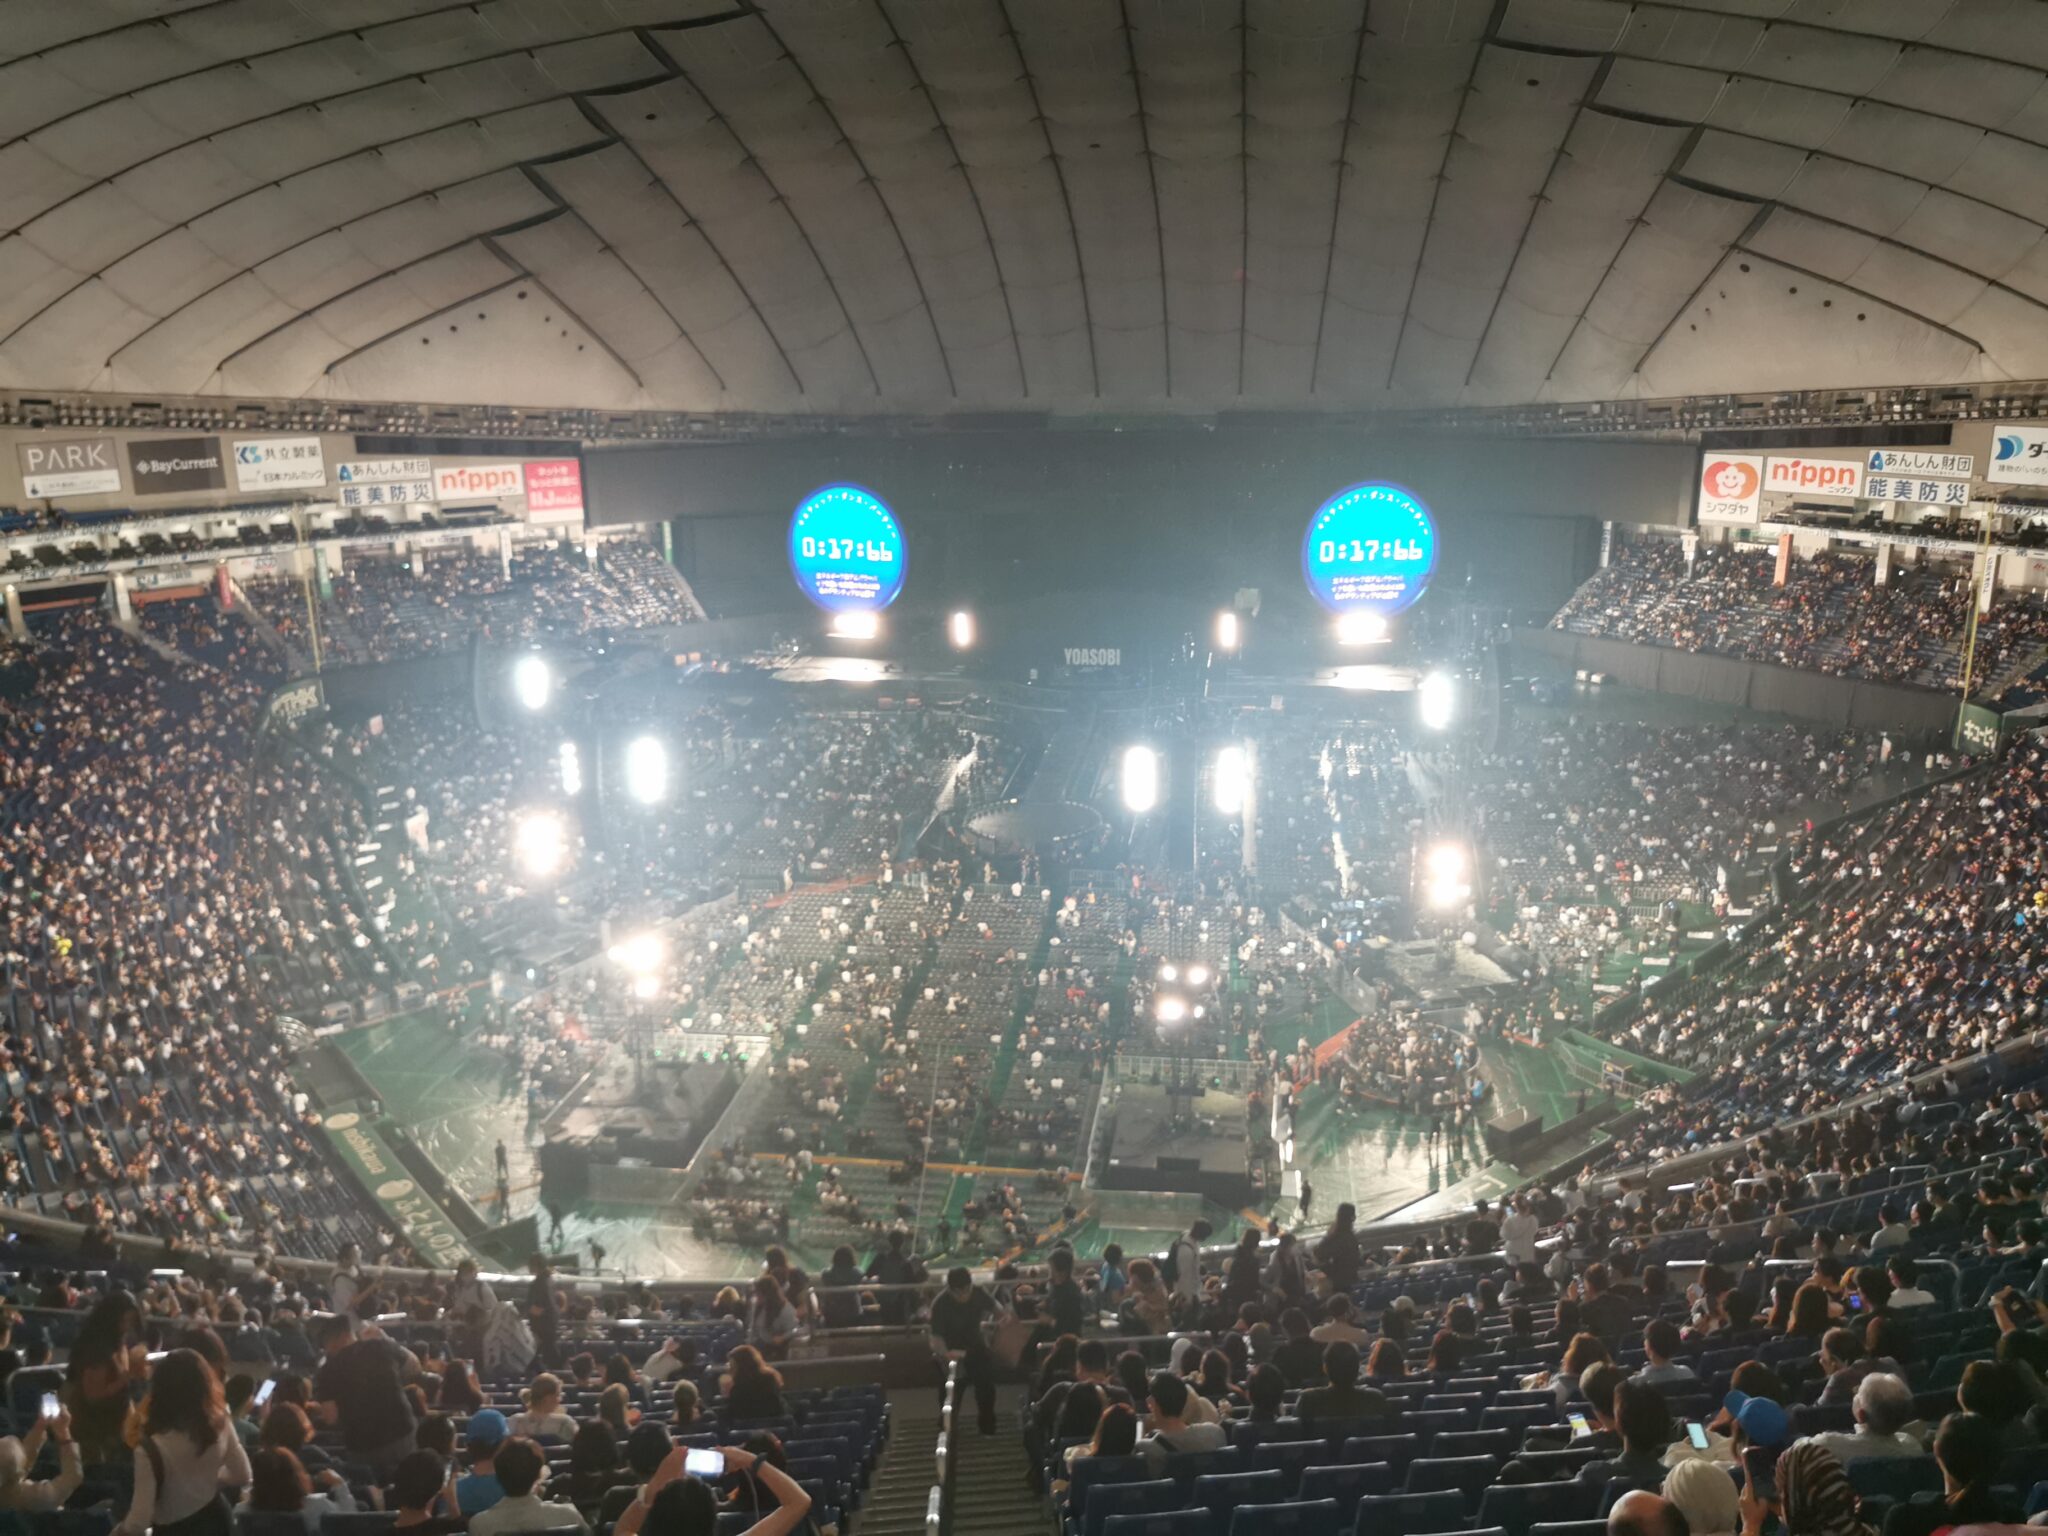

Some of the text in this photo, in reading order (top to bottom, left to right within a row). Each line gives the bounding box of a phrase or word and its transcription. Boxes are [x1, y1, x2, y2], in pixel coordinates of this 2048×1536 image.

[27, 444, 107, 472] PARK
[265, 445, 320, 461] 共立製薬
[1885, 452, 1971, 472] あんしん財団
[150, 457, 219, 474] BayCurrent
[352, 460, 430, 476] あんしん財団
[1772, 460, 1856, 488] nippn
[263, 470, 324, 484] 日本カルミック
[441, 468, 518, 493] nippn
[343, 484, 432, 505] 能美防災
[1868, 478, 1966, 505] 能美防災
[1706, 502, 1749, 516] シマダヤ
[1064, 648, 1121, 666] YOASOBI
[396, 1197, 482, 1269] ふとんの西
